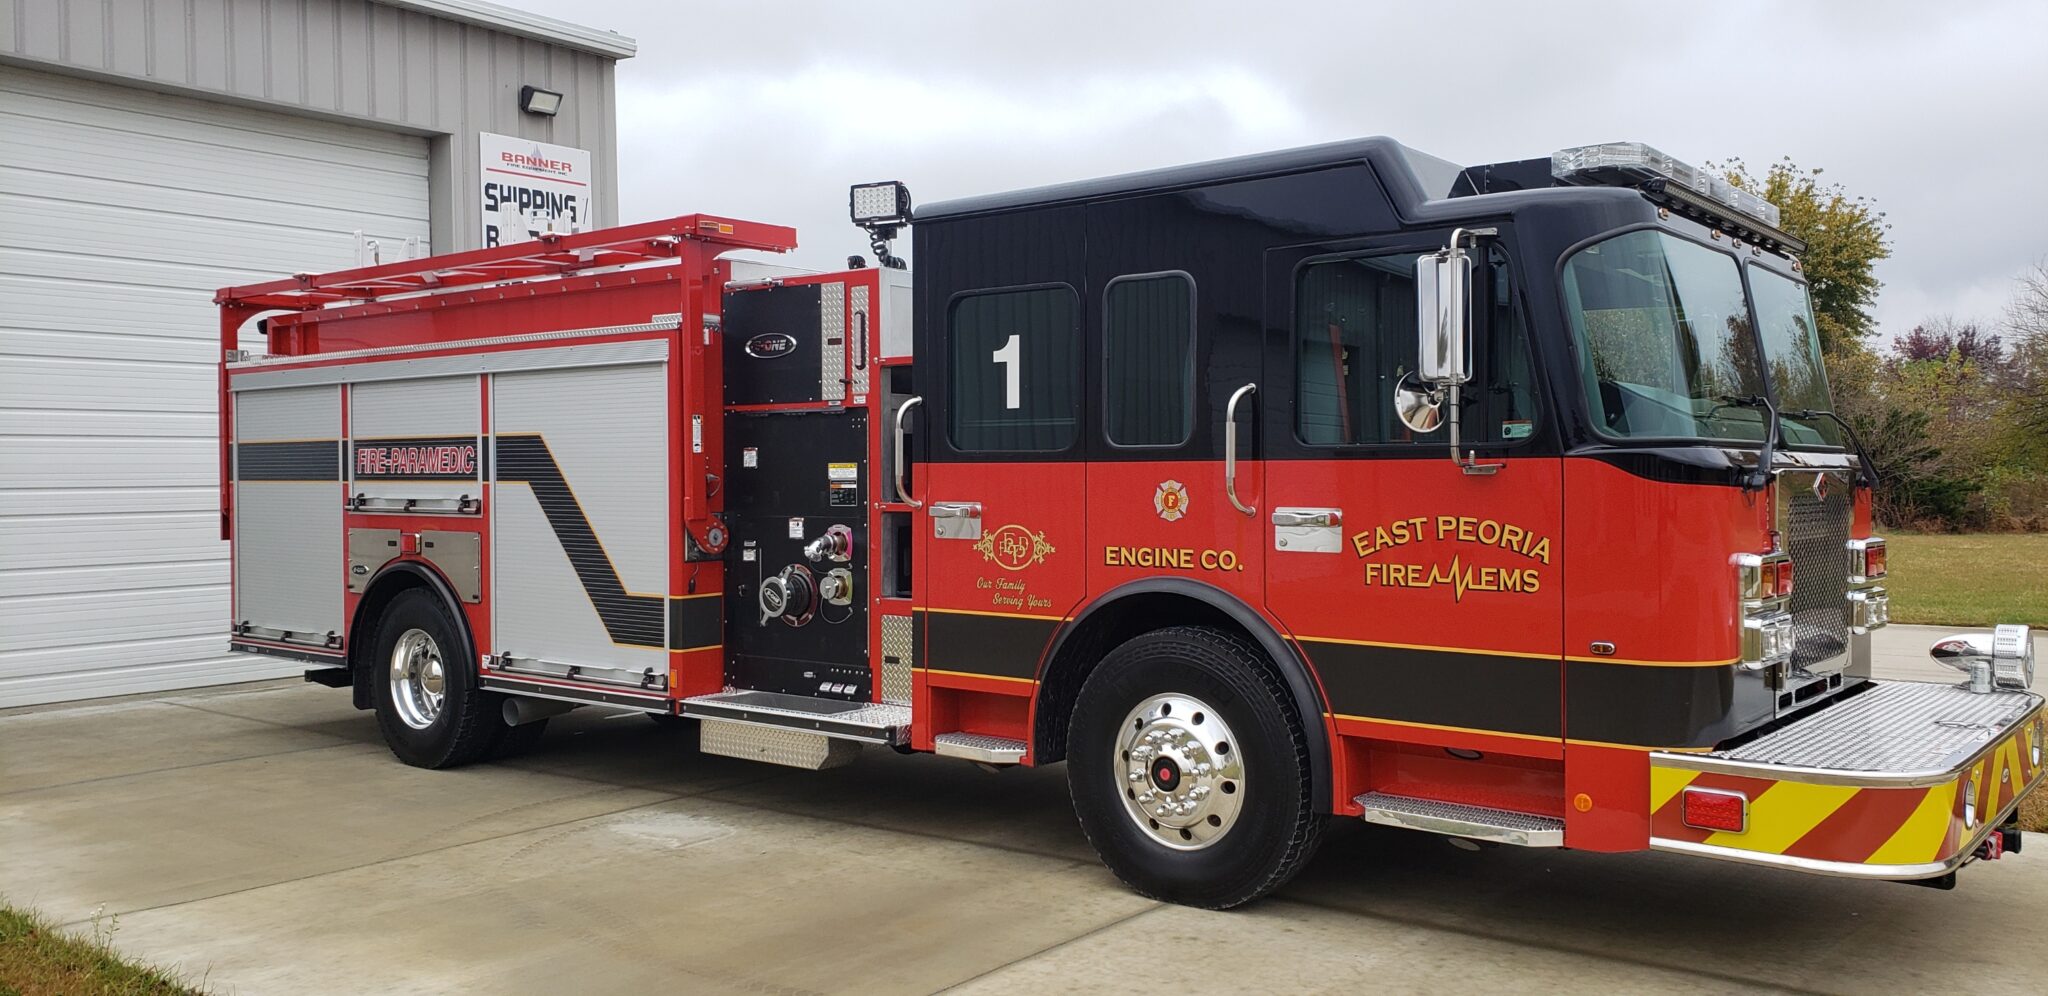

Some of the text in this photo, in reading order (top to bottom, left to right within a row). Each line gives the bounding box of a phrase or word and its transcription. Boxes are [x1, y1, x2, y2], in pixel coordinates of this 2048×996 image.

[501, 152, 572, 172] BANNER
[993, 334, 1020, 409] 1
[357, 446, 475, 474] FIRE-PARAMEDIC
[1352, 516, 1551, 564] EAST PEORIA
[1105, 546, 1244, 571] ENGINE CO.
[977, 576, 1026, 595] Our Family
[1365, 563, 1541, 593] FIRE EMS
[993, 592, 1052, 611] Serving Yours
